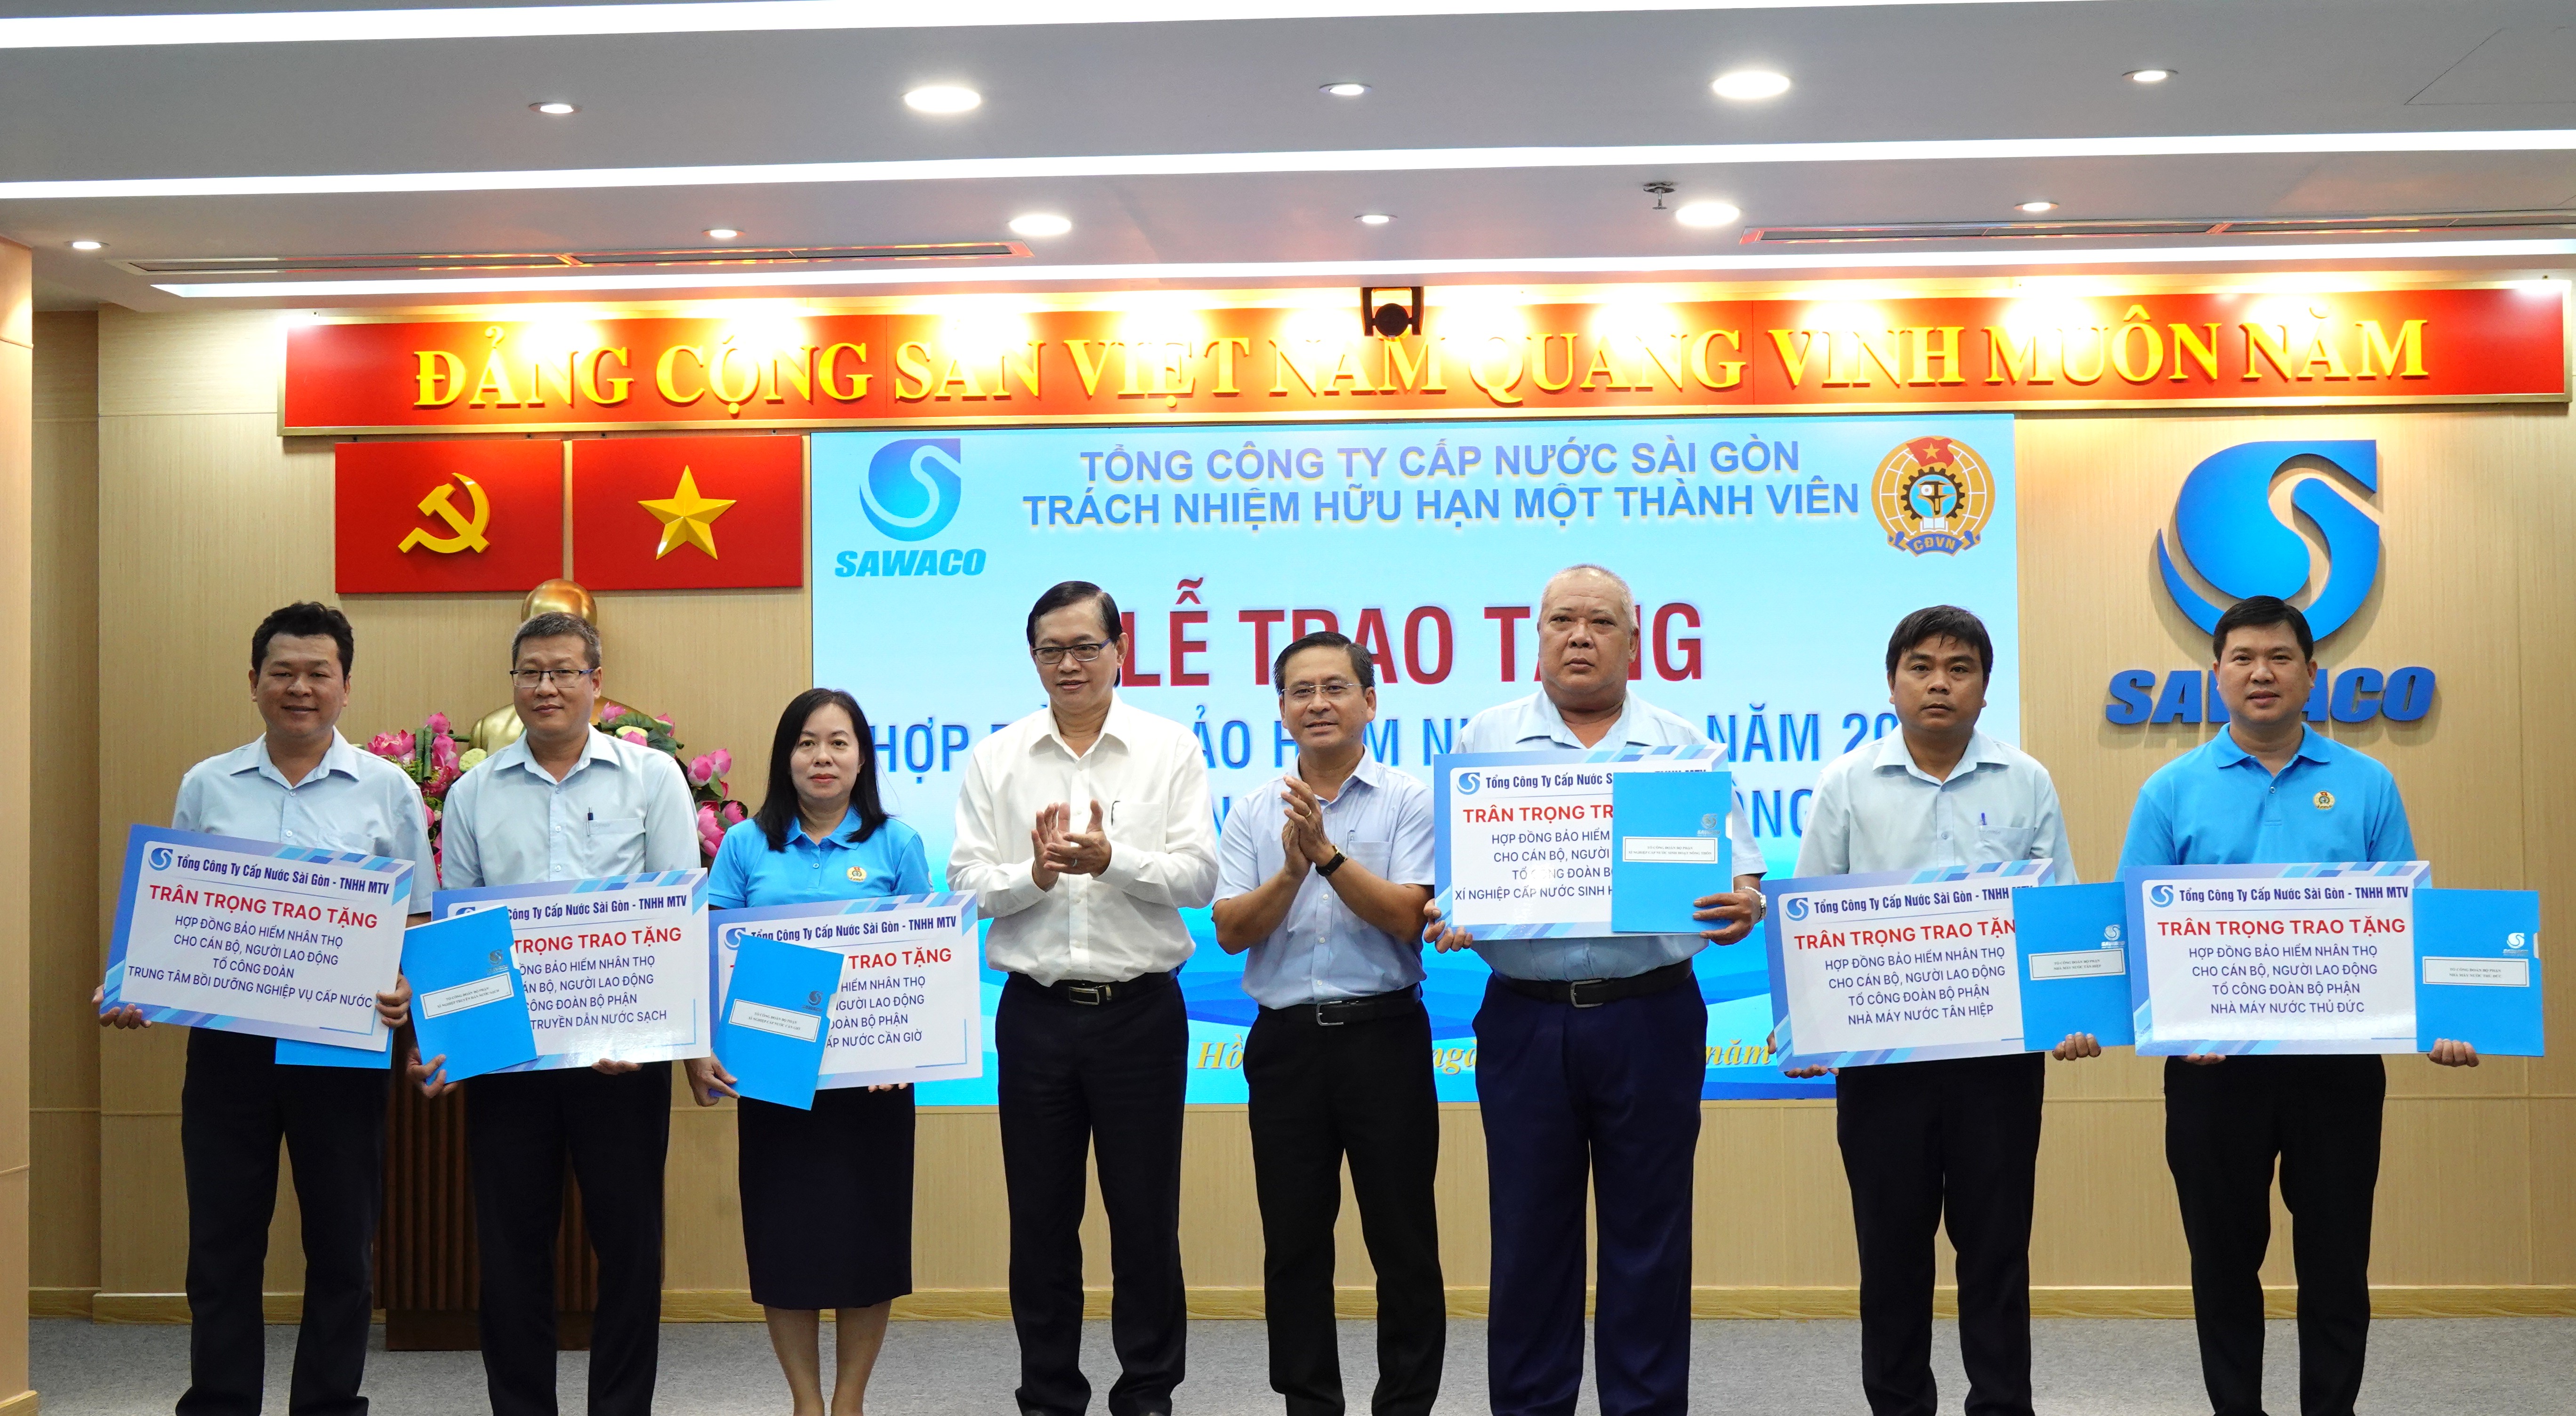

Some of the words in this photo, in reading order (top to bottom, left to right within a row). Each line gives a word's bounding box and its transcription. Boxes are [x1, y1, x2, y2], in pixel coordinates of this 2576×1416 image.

[413, 326, 634, 406] ĐẢNG
[656, 334, 873, 415] CỘNG
[1269, 336, 1447, 397] NAM
[1470, 329, 1746, 406] QUANG
[1768, 327, 1965, 389] VINH
[1984, 304, 2222, 386] MUÔN
[2240, 307, 2428, 382] NĂM
[1080, 444, 1192, 481] TỔNG
[1207, 441, 1323, 480] CÔNG
[1337, 447, 1387, 477] TY
[1400, 438, 1481, 476] CẤP
[1496, 436, 1617, 475] NƯỚC
[1632, 434, 1695, 474] SÀI
[1710, 434, 1798, 472] GÒN
[1023, 487, 1159, 525] TRÁCH
[1175, 487, 1299, 531] NHIỆM
[1315, 483, 1401, 521] HỮU
[1417, 489, 1499, 527] HẠN
[1515, 483, 1602, 526] MỘT
[1614, 478, 1752, 517] THÀNH
[1766, 475, 1858, 514] VIÊN
[1913, 536, 1957, 551] CĐVN
[835, 548, 987, 578] SAWACO
[1122, 577, 1209, 687] LỄ
[869, 717, 969, 784] HỢP
[1192, 705, 1250, 769] ẢO
[1707, 703, 1819, 762] NĂM
[1463, 805, 1513, 823] TRÂN
[1519, 805, 1585, 824] TRỌNG
[1590, 804, 1613, 819] TR
[1492, 834, 1516, 845] HỢP
[1518, 830, 1552, 843] ĐỒNG
[1555, 829, 1578, 842] BẢO
[1582, 828, 1610, 841] HIỂM
[177, 854, 201, 871] Tổng
[202, 859, 228, 875] Công
[231, 862, 241, 877] Ty
[243, 863, 262, 879] Cấp
[264, 867, 290, 882] Nước
[292, 871, 309, 884] Sài
[311, 873, 330, 887] Gòn
[340, 877, 366, 892] TNHH
[368, 881, 389, 895] MTV
[150, 884, 199, 905] TRÂN
[204, 892, 266, 914] TRỌNG
[272, 901, 322, 921] TRAO
[327, 907, 378, 928] TẶNG
[532, 907, 542, 919] Ty
[545, 903, 563, 918] Cấp
[566, 903, 590, 916] Nước
[593, 901, 608, 914] Sài
[612, 900, 629, 912] Gòn
[638, 897, 664, 910] TNHH
[667, 895, 687, 908] MTV
[1455, 887, 1465, 900] XÍ
[1469, 886, 1510, 901] NGHIỆP
[1540, 884, 1575, 897] NƯỚC
[1578, 885, 1604, 896] SINH
[175, 915, 198, 927] HỢP
[200, 917, 231, 932] ĐỒNG
[233, 921, 256, 935] BẢO
[258, 925, 285, 939] HIỂM
[287, 930, 318, 944] NHÂN
[321, 934, 343, 947] THỌ
[514, 936, 573, 956] TRỌNG
[578, 932, 627, 949] TRAO
[631, 926, 681, 947] TẶNG
[1794, 930, 1845, 949] TRÂN
[1850, 927, 1916, 947] TRỌNG
[1920, 923, 1972, 940] TRAO
[1977, 917, 2015, 938] TẶN
[2157, 917, 2210, 936] TRÂN
[2215, 920, 2284, 938] TRỌNG
[2289, 919, 2344, 934] TRAO
[2349, 916, 2405, 937] TẶNG
[174, 934, 197, 947] CHO
[200, 936, 223, 950] CÁN
[225, 939, 242, 955] BỘ,
[245, 944, 282, 957] NGƯỜI
[283, 949, 305, 961] LAO
[307, 950, 338, 965] ĐỘNG
[848, 952, 897, 969] TRAO
[902, 947, 951, 968] TẶNG
[213, 956, 227, 969] TỔ
[230, 959, 261, 974] CÔNG
[263, 964, 294, 979] ĐOÀN
[129, 965, 164, 980] TRUNG
[168, 969, 191, 984] TÂM
[193, 974, 211, 986] BỒI
[213, 977, 254, 992] DƯỠNG
[256, 983, 296, 999] NGHIỆP
[298, 989, 313, 1002] VỤ
[315, 990, 338, 1003] CẤP
[339, 994, 372, 1008] NƯỚC
[841, 978, 867, 992] HIỂM
[870, 976, 900, 990] NHÂN
[903, 976, 925, 987] THỌ
[531, 1014, 572, 1030] TRUYỀN
[576, 1012, 598, 1027] DẪN
[601, 1010, 634, 1024] NƯỚC
[637, 1010, 667, 1023] SẠCH
[1848, 1011, 1873, 1025] NHÀ
[1876, 1009, 1900, 1023] MÁY
[1904, 1006, 1939, 1021] NƯỚC
[1941, 1005, 1965, 1018] TÂN
[1968, 1002, 1993, 1017] HIỆP
[2211, 1000, 2237, 1014] NHÀ
[2239, 1000, 2266, 1014] MÁY
[2270, 1000, 2306, 1013] NƯỚC
[2309, 999, 2334, 1013] THỦ
[2336, 999, 2365, 1013] ĐỨC
[826, 1035, 839, 1048] ẤP
[842, 1033, 875, 1047] NƯỚC
[877, 1031, 900, 1044] CẦN
[903, 1029, 922, 1042] GIỜ
[1195, 1034, 1244, 1070] Hồ
[1706, 1038, 1771, 1065] năm
